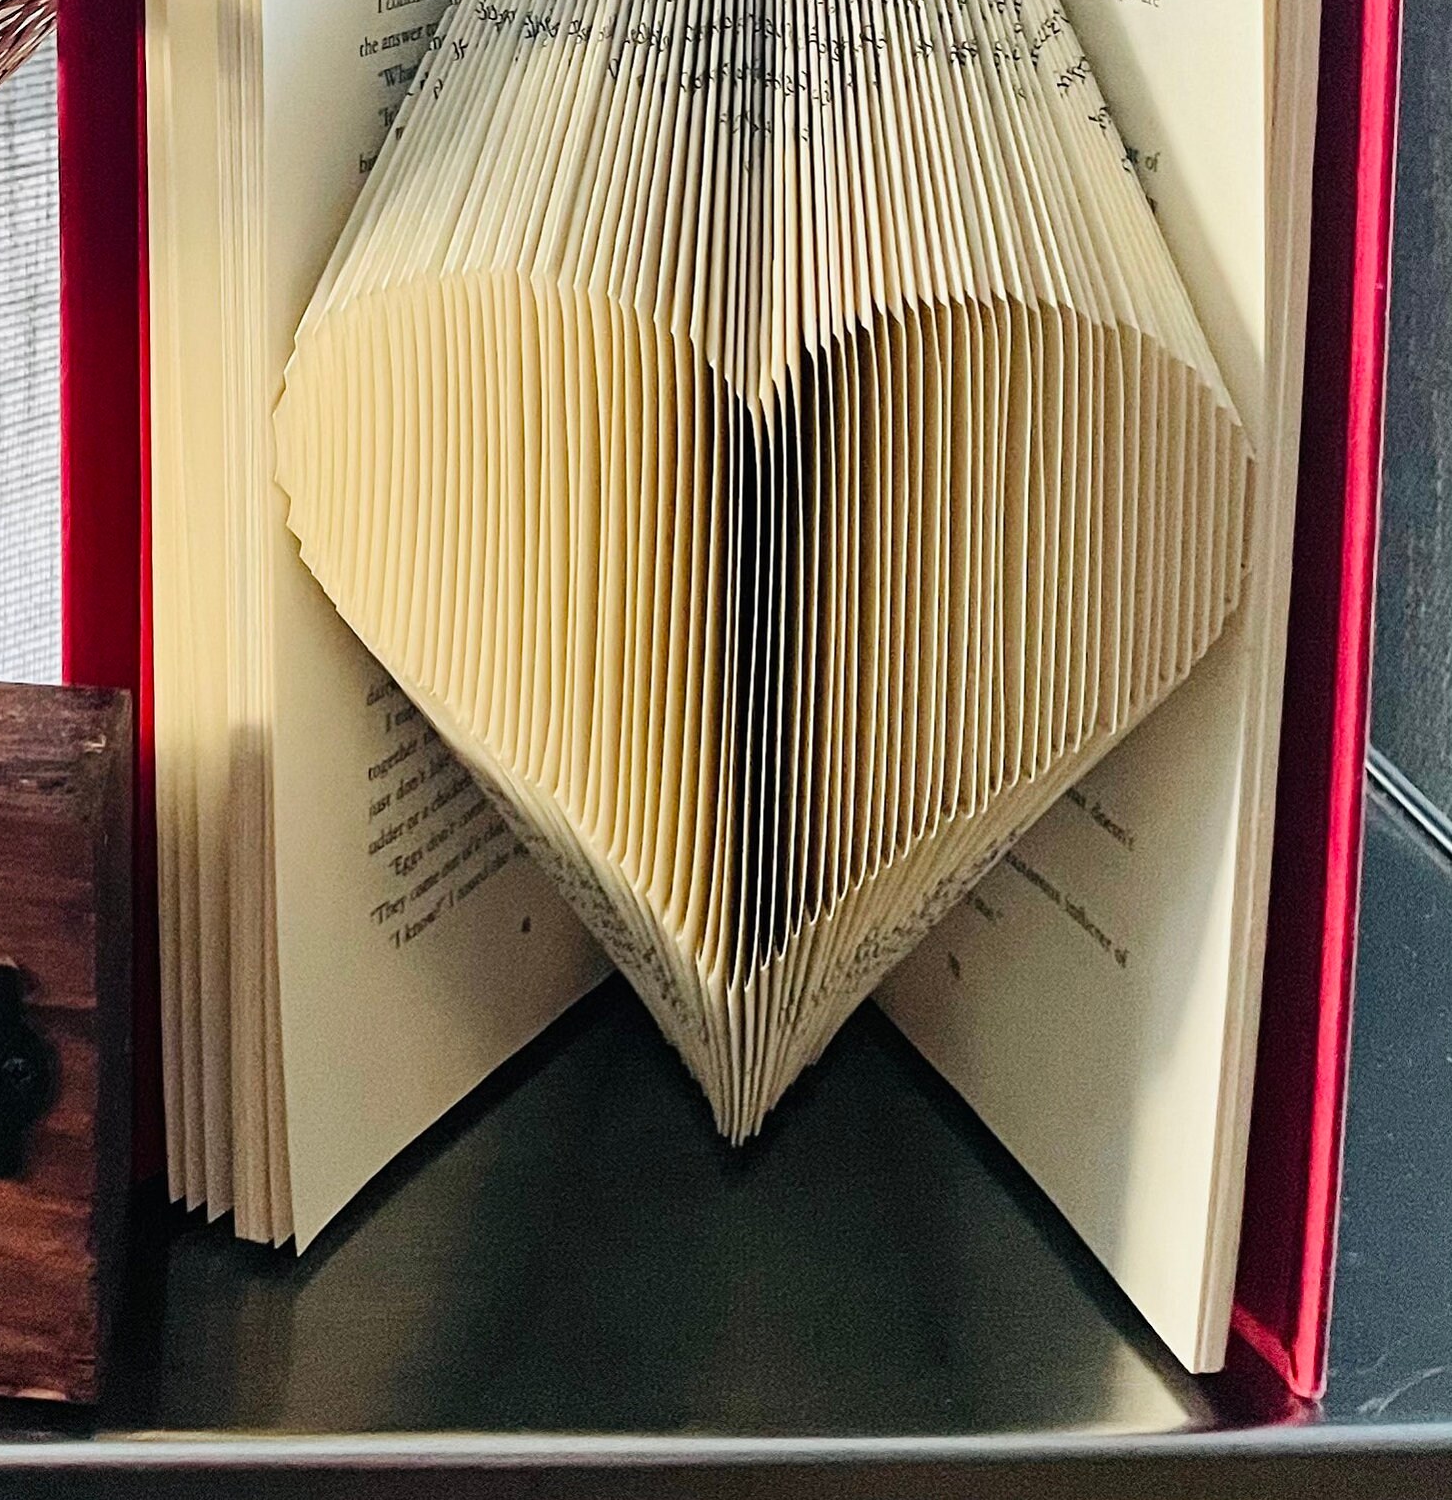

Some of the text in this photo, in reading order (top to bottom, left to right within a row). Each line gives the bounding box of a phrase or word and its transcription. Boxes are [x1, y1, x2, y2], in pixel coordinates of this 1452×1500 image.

[360, 36, 379, 58] the
[381, 25, 423, 51] answer
[1146, 149, 1161, 173] of
